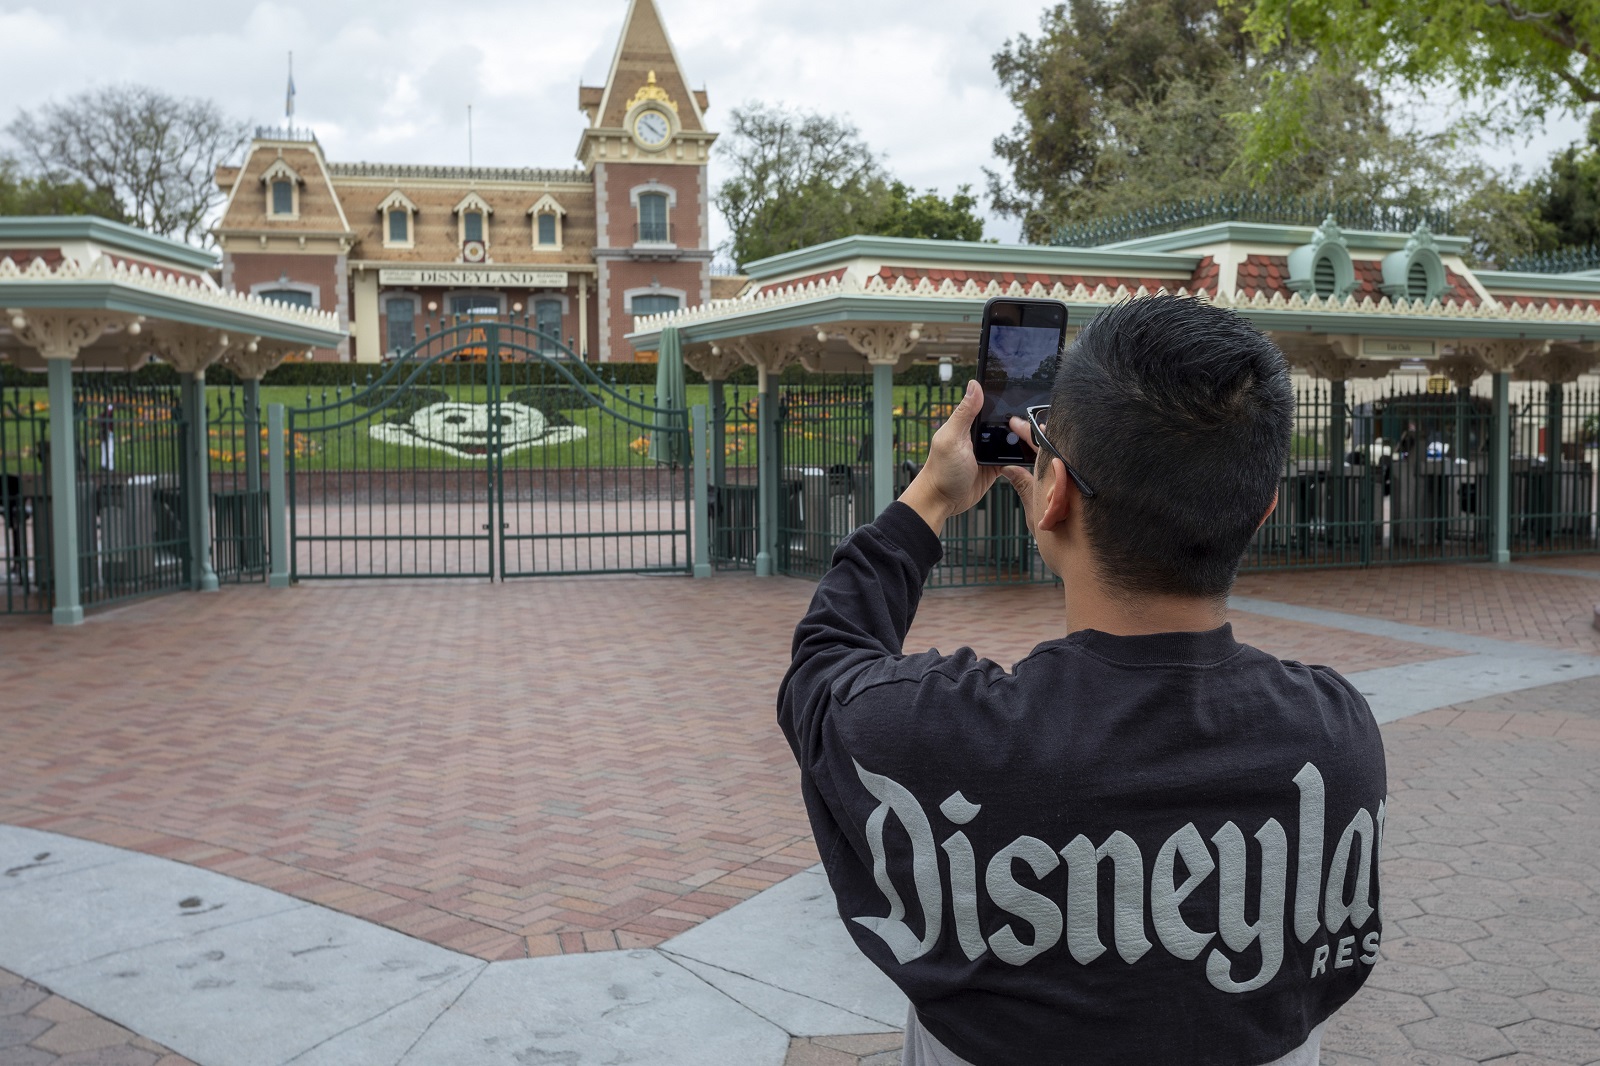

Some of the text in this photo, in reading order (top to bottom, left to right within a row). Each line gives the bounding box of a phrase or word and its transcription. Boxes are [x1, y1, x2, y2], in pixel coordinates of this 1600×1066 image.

[420, 271, 534, 284] DISNEYLAND
[851, 755, 1387, 993] Disneyla
[1310, 931, 1380, 979] RES
